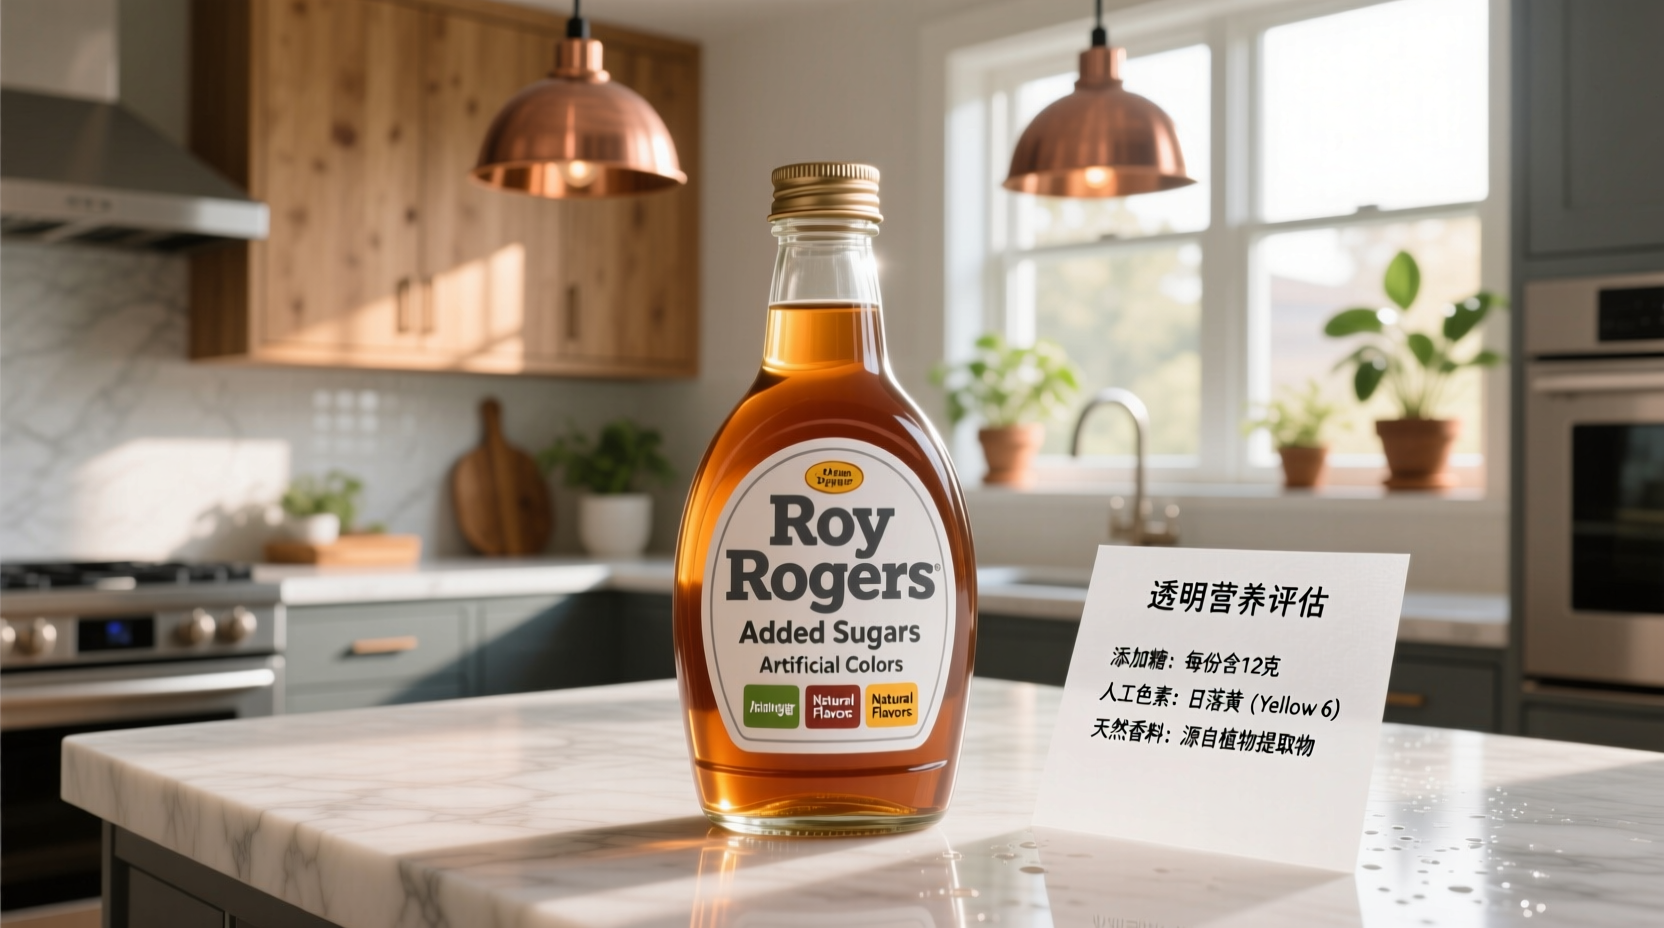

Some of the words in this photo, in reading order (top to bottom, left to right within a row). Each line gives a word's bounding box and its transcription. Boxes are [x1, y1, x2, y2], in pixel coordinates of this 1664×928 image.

[769, 494, 895, 559] Roy
[1147, 579, 1329, 619] 透明营养评估
[739, 620, 825, 644] Added
[833, 620, 921, 650] Sugars
[759, 656, 840, 674] Artificial
[845, 656, 903, 674] Colors
[872, 691, 913, 705] Natural
[872, 704, 913, 719] Flavors
